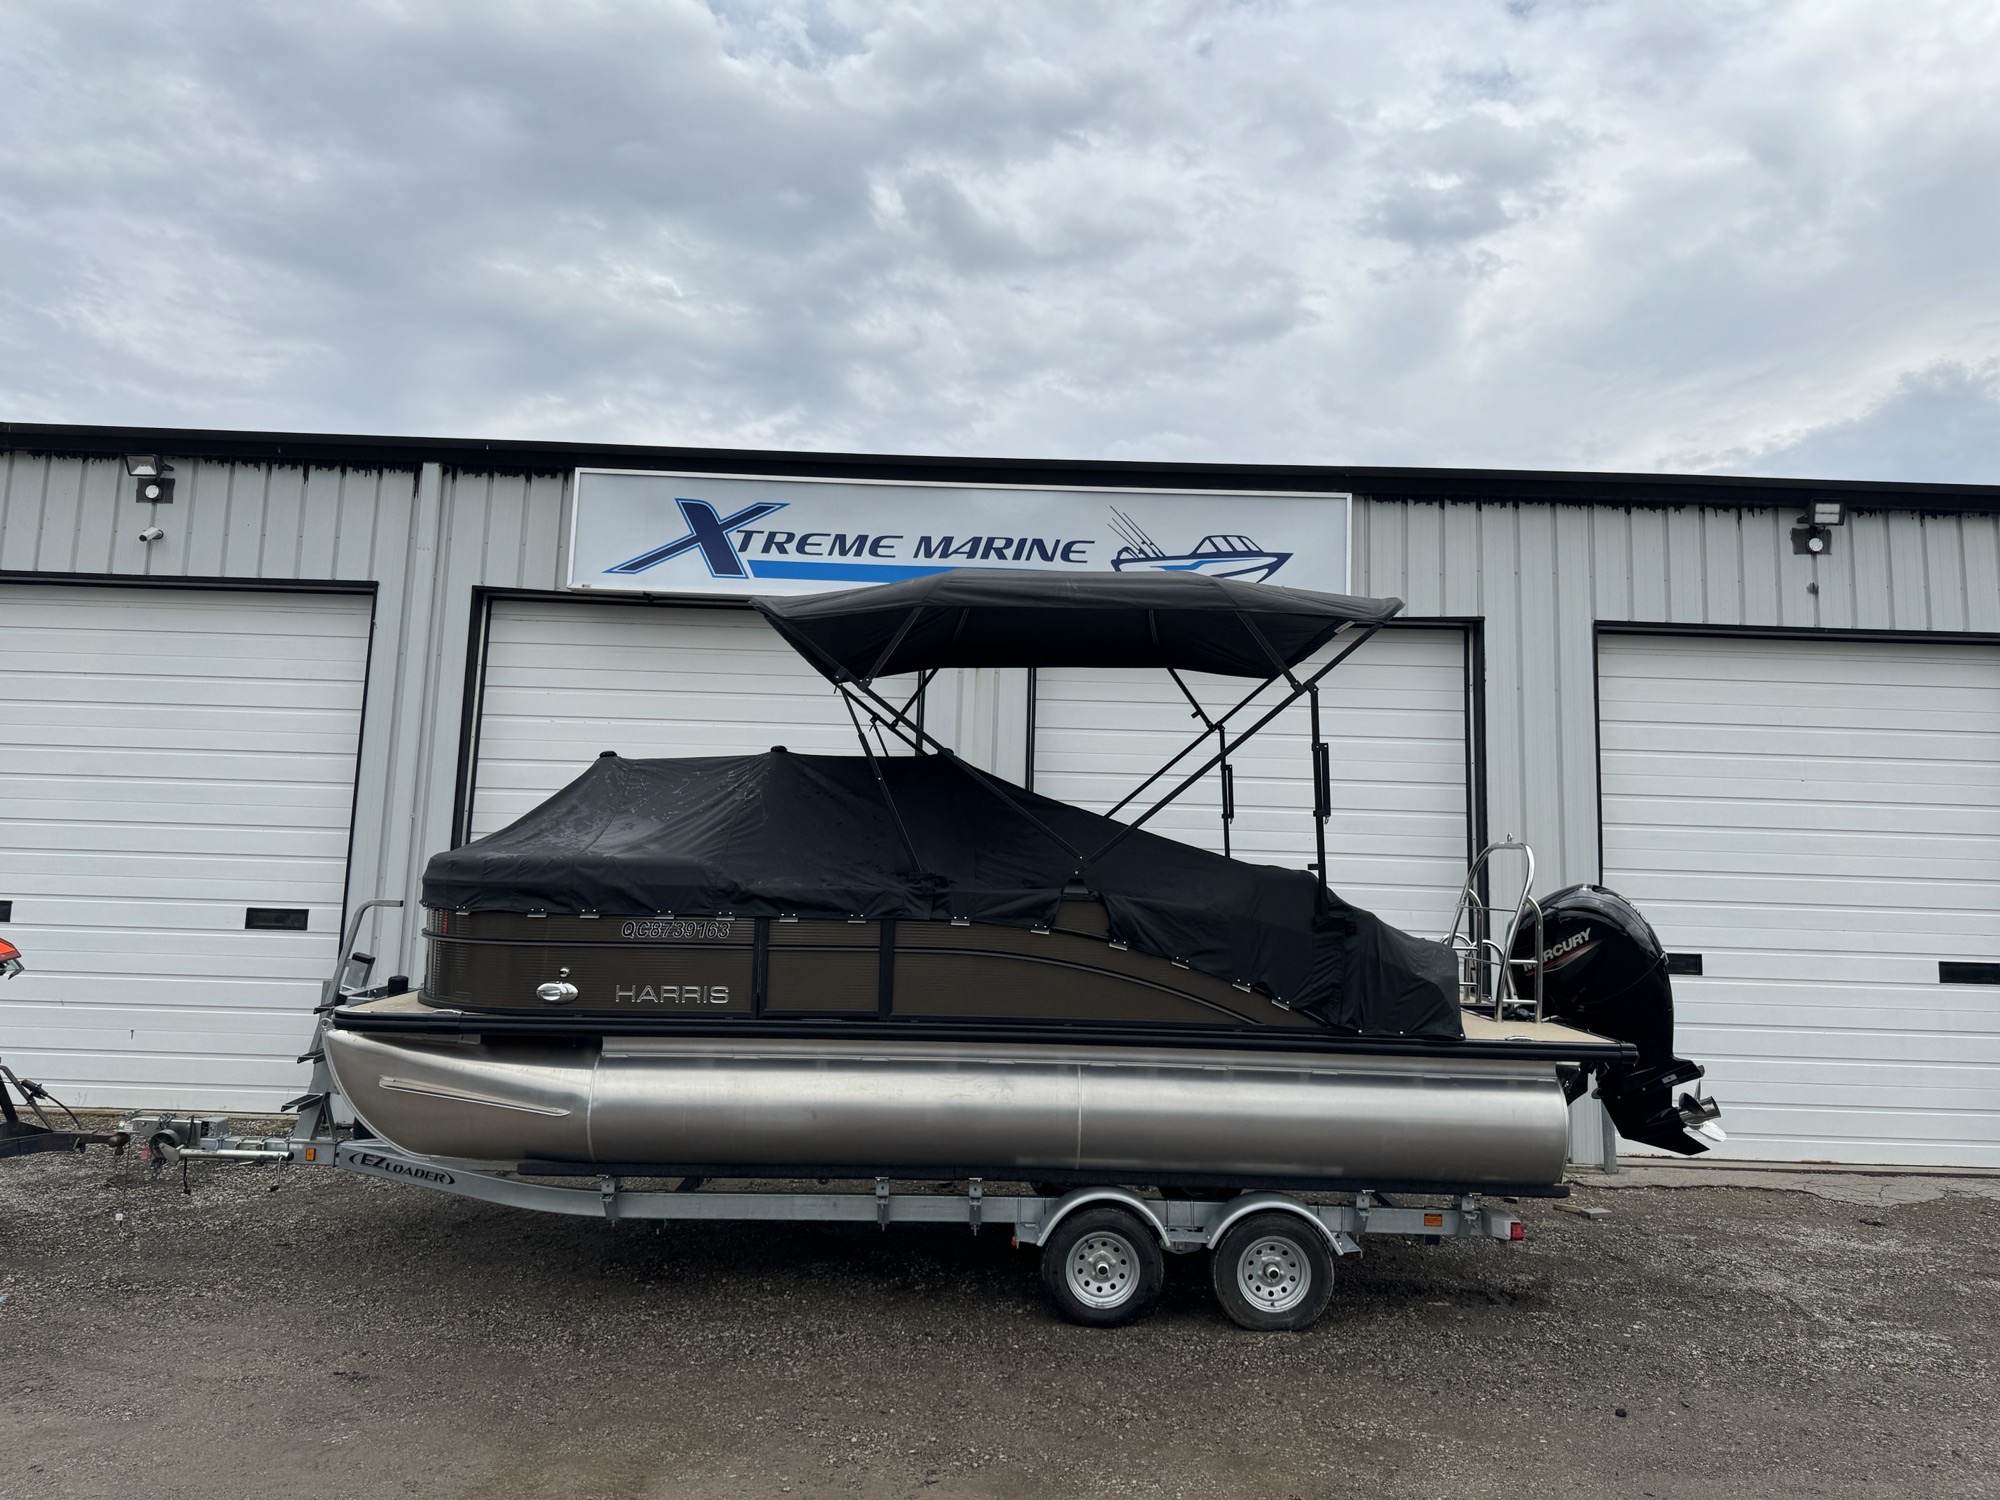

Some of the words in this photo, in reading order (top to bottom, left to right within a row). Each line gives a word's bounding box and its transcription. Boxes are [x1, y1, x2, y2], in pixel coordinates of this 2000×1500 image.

[602, 498, 904, 579] XTREME
[913, 535, 1095, 563] MARINE
[621, 921, 731, 938] QC8739163
[1523, 927, 1592, 972] MRCURY
[615, 984, 729, 1004] HARRIS
